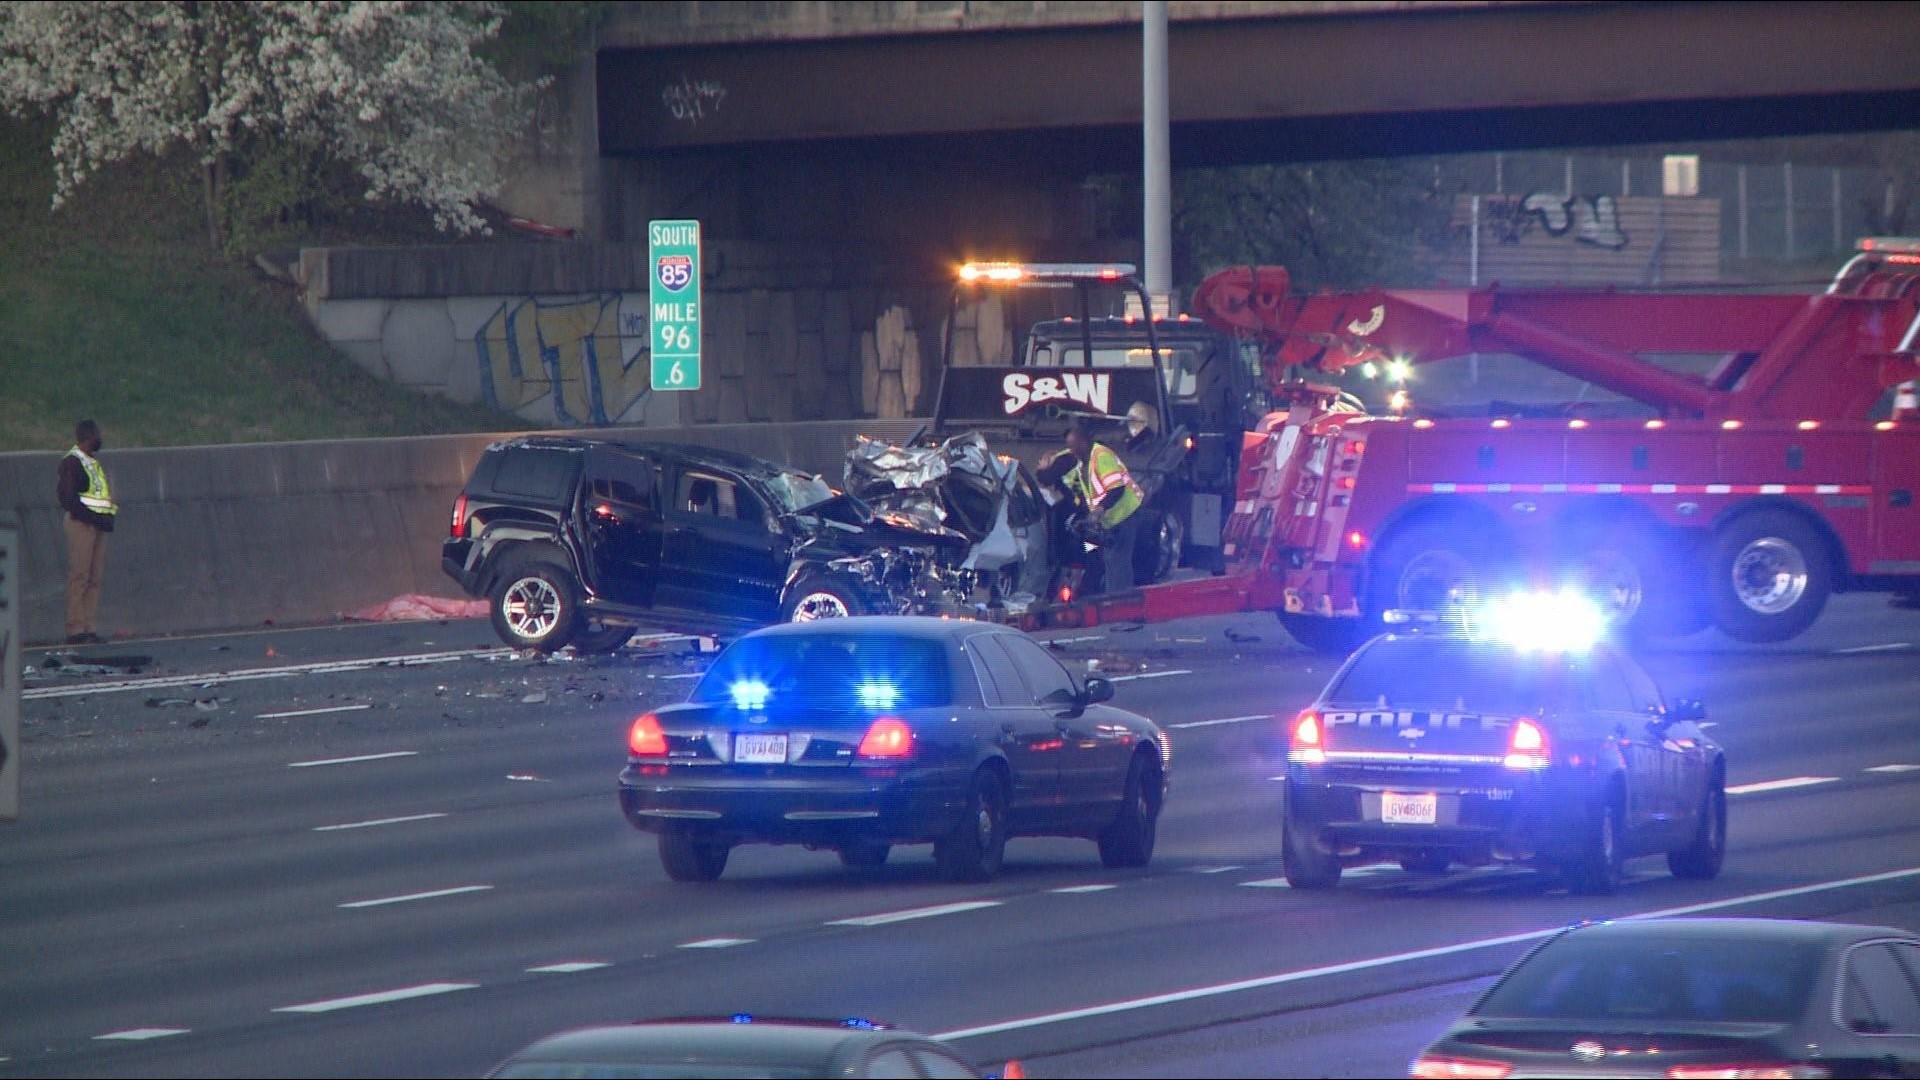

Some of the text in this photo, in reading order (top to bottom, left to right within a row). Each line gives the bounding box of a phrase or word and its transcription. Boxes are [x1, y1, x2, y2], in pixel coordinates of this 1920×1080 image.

[652, 225, 697, 246] SOUTH
[661, 265, 688, 285] 85
[655, 303, 697, 322] MILE
[661, 325, 691, 350] 96
[665, 361, 684, 384] .6
[1002, 372, 1110, 415] S&W
